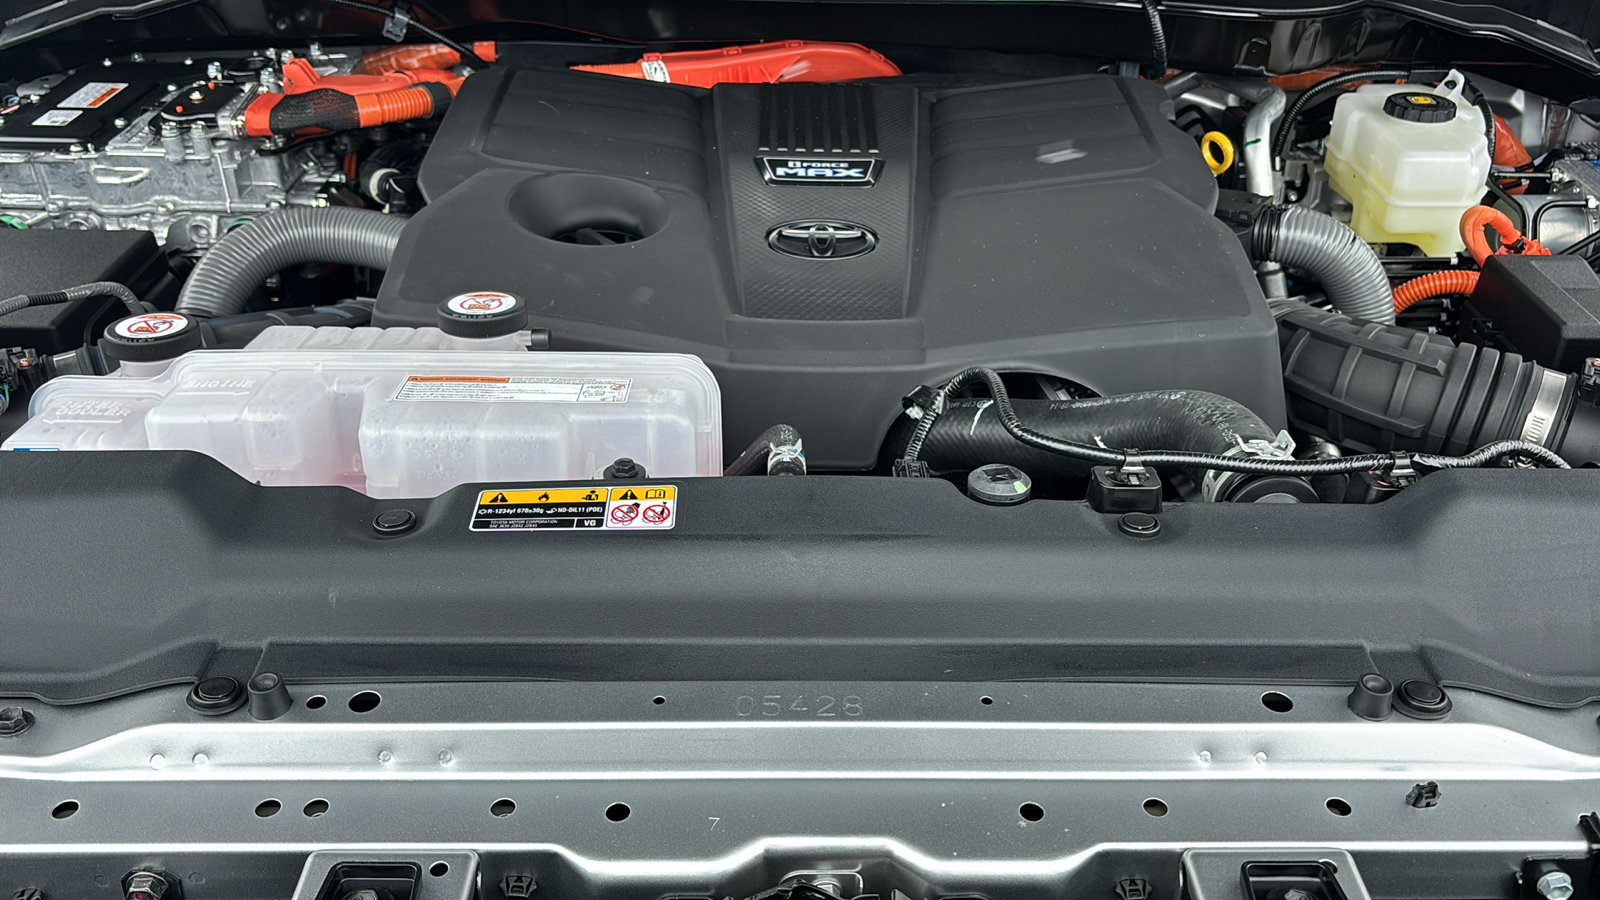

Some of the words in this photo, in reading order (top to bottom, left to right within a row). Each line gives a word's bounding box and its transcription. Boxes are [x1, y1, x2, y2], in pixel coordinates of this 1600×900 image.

[776, 167, 865, 177] MAX
[417, 470, 460, 479] DENSO
[735, 695, 864, 717] 05428
[708, 816, 721, 831] 7
